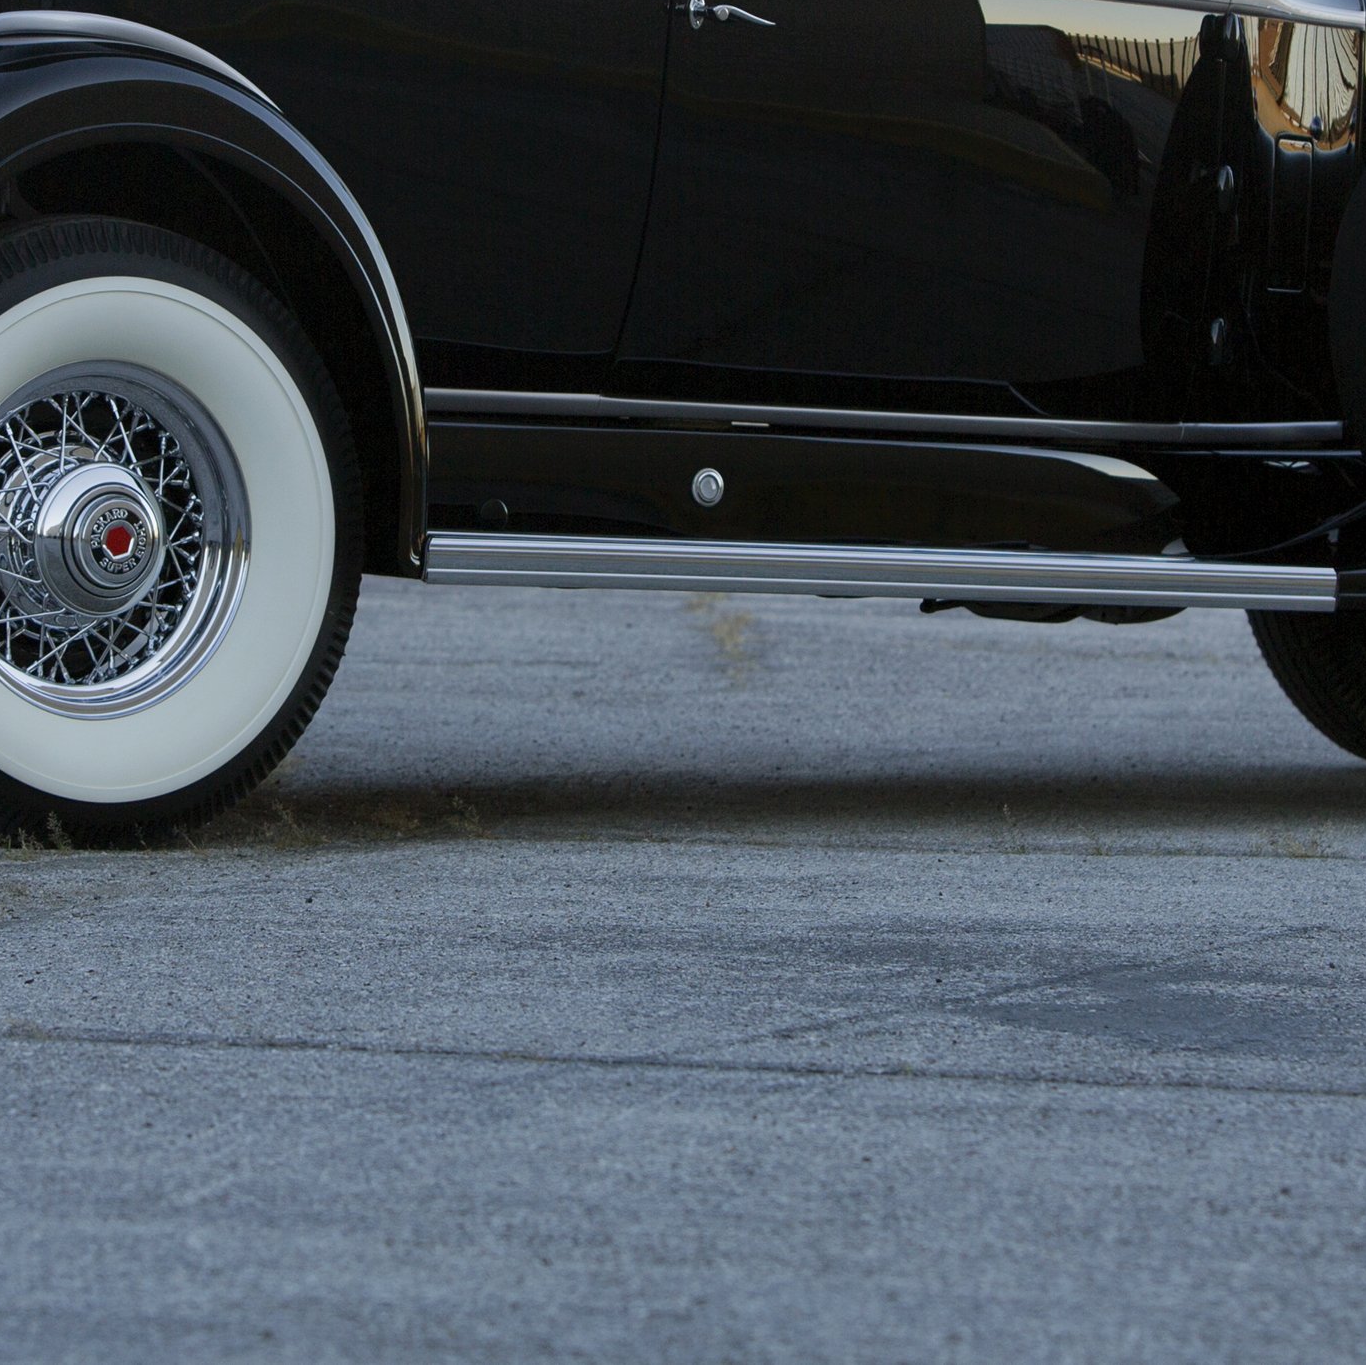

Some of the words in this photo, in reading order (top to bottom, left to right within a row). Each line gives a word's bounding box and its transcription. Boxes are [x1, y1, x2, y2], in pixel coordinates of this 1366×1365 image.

[90, 508, 129, 549] PACKARD
[99, 557, 137, 573] SUPER
[134, 520, 146, 560] EIGHT
